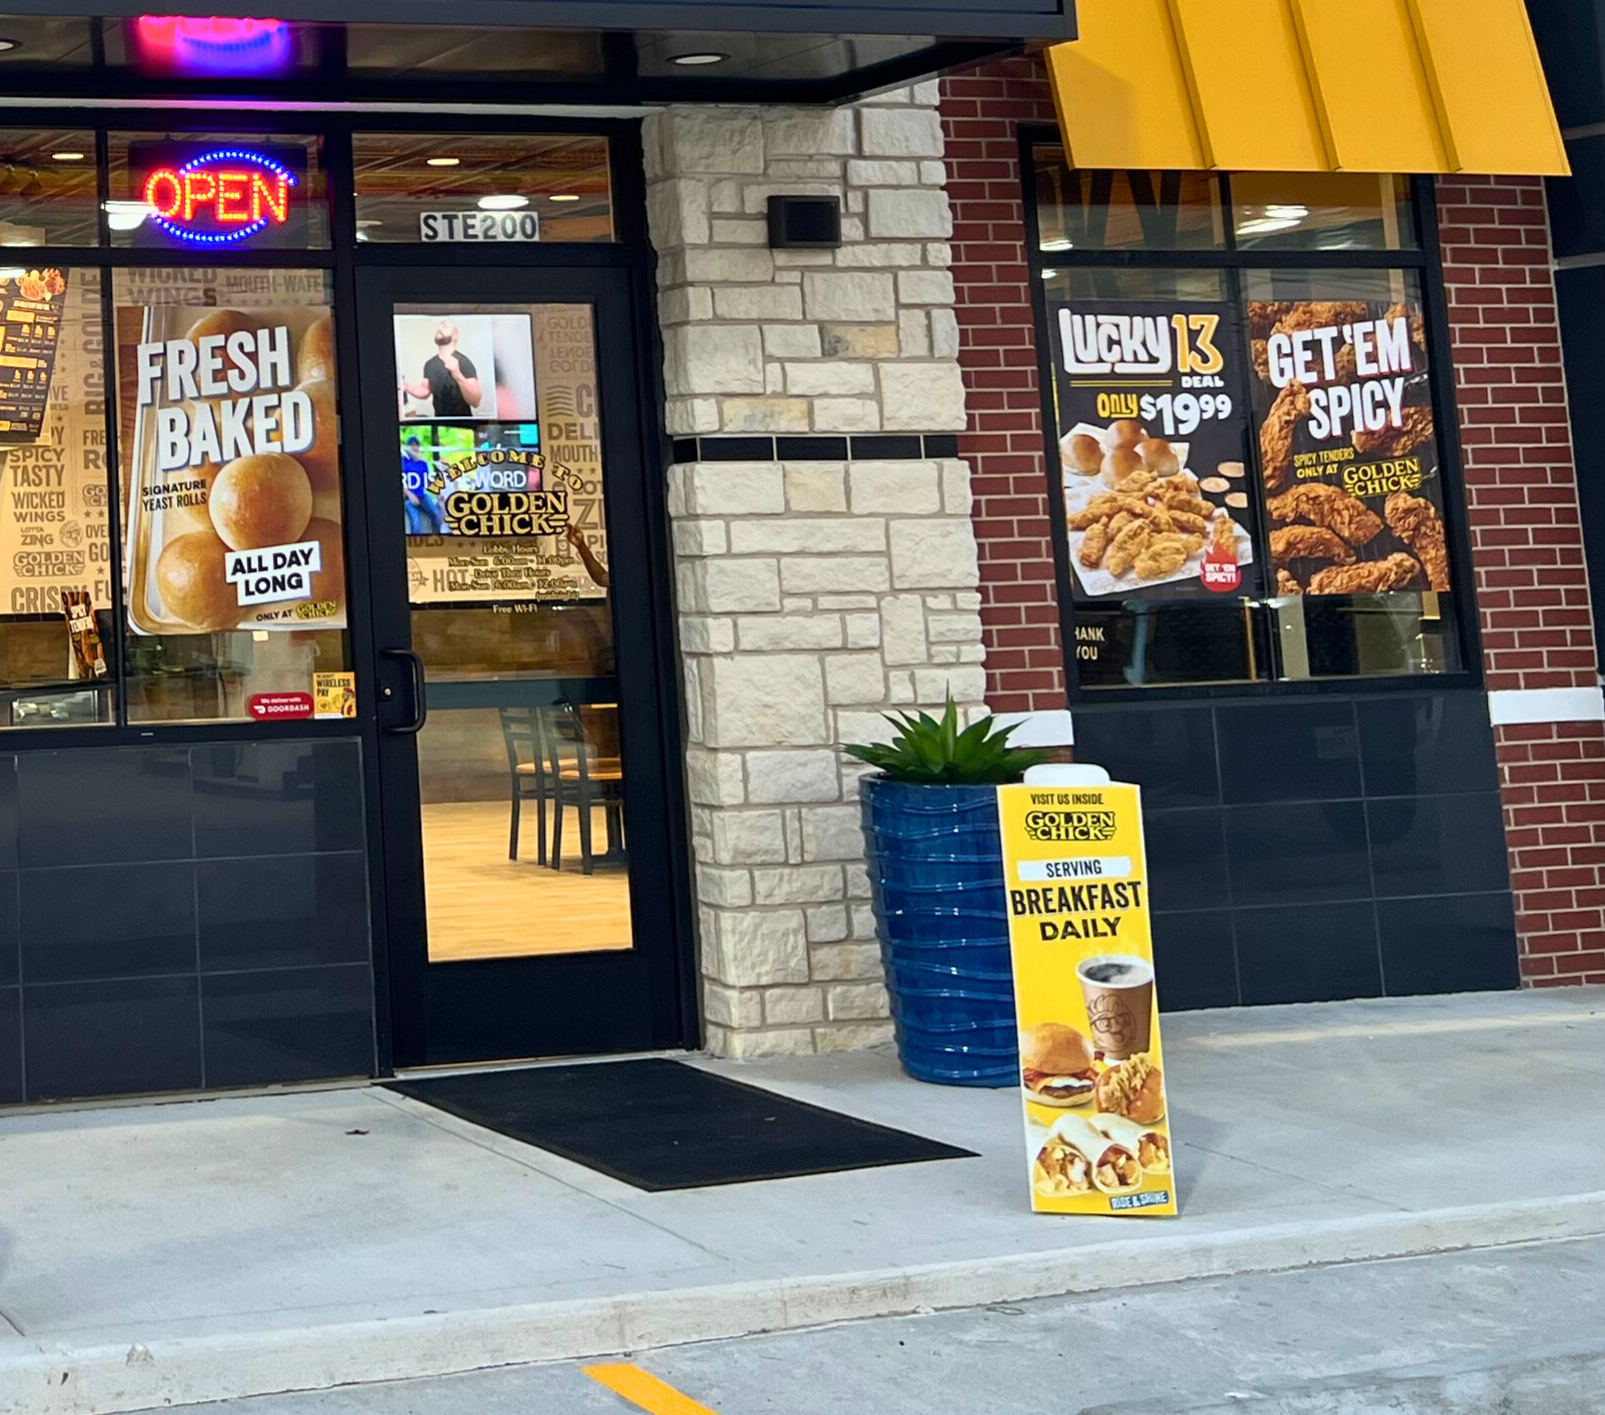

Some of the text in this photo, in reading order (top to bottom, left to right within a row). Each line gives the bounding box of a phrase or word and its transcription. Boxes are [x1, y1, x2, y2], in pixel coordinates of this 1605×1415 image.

[144, 167, 288, 224] OPEN
[422, 213, 537, 241] STE200
[1058, 308, 1224, 374] LUCKY 13
[1267, 317, 1412, 388] GET 'EM
[137, 326, 291, 405] FRESH
[1181, 376, 1225, 388] DEAL
[1307, 377, 1405, 440] SPICY
[157, 391, 314, 470] BAKED
[9, 448, 66, 463] SPICY
[1294, 447, 1355, 467] SPICY TENDERS
[9, 465, 65, 487] TASTY
[427, 449, 546, 495] WELCOME
[552, 461, 584, 491] TO
[474, 470, 527, 489] WORD
[1296, 463, 1339, 479] ONLY AT
[1343, 458, 1419, 484] GOLDEN
[142, 479, 207, 496] SIGNATURE
[1355, 475, 1413, 496] CHICK
[11, 491, 65, 510] WICKED
[142, 491, 207, 512] YEAST ROLLS
[447, 490, 566, 518] GOLDEN
[13, 511, 66, 523] WINGS
[460, 514, 554, 535] CHICK
[20, 535, 54, 548] ZING
[483, 543, 539, 555] Lobby Hours
[14, 551, 86, 566] GOLDEN
[231, 548, 314, 576] ALL DAY
[22, 564, 77, 577] CHICK
[474, 567, 551, 578] Drive Thru Hours
[245, 573, 303, 597] LONG
[255, 610, 292, 622] ONLY AT
[493, 604, 512, 613] Free
[317, 678, 351, 688] WIRELESS
[317, 689, 329, 697] PAY
[267, 704, 310, 713] DOORDASH
[1030, 793, 1104, 805] VISIT US INSIDE
[1026, 811, 1115, 830] GOLDEN
[1036, 826, 1104, 841] CHICK
[1046, 859, 1102, 878] SERVING
[1010, 881, 1141, 916] BREAKFAST
[1039, 916, 1121, 941] DAILY
[1111, 1192, 1168, 1210] RISE & SHINE
